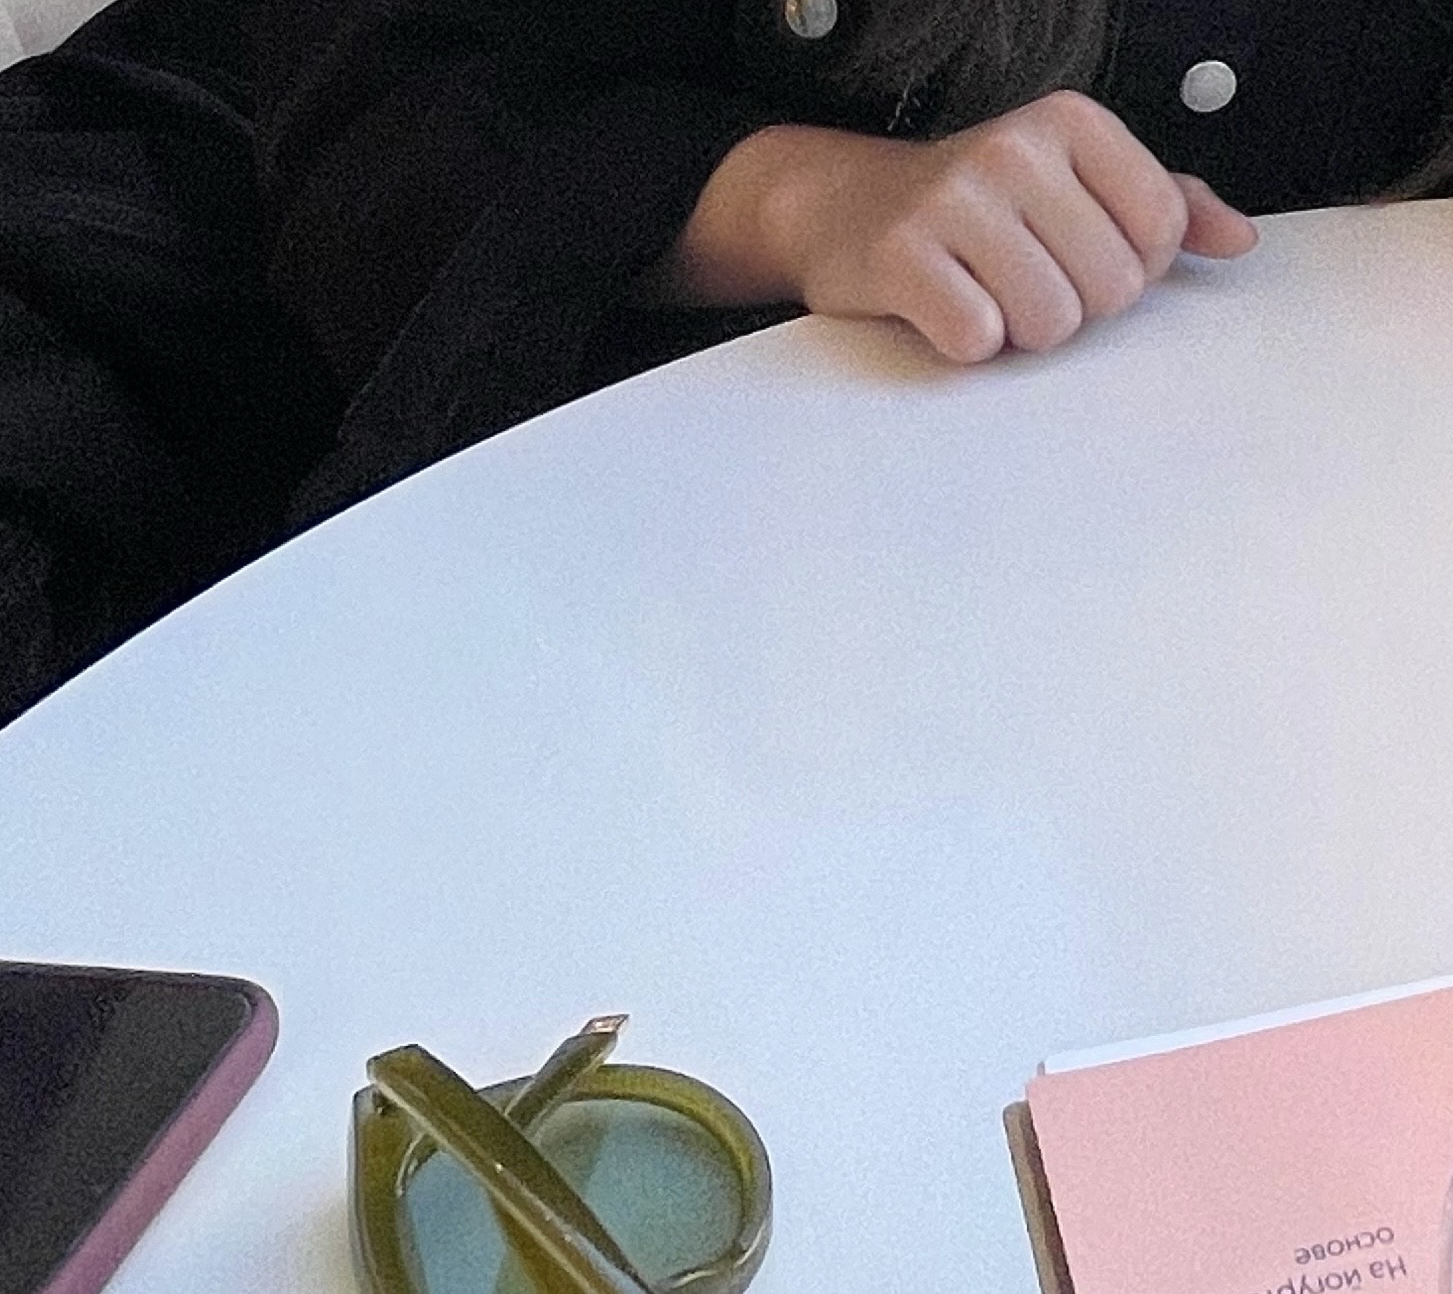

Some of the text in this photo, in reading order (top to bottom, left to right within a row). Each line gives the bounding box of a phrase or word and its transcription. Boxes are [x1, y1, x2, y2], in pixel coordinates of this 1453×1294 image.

[1294, 1227, 1395, 1266] основе
[1266, 1256, 1407, 1294] На йогур
